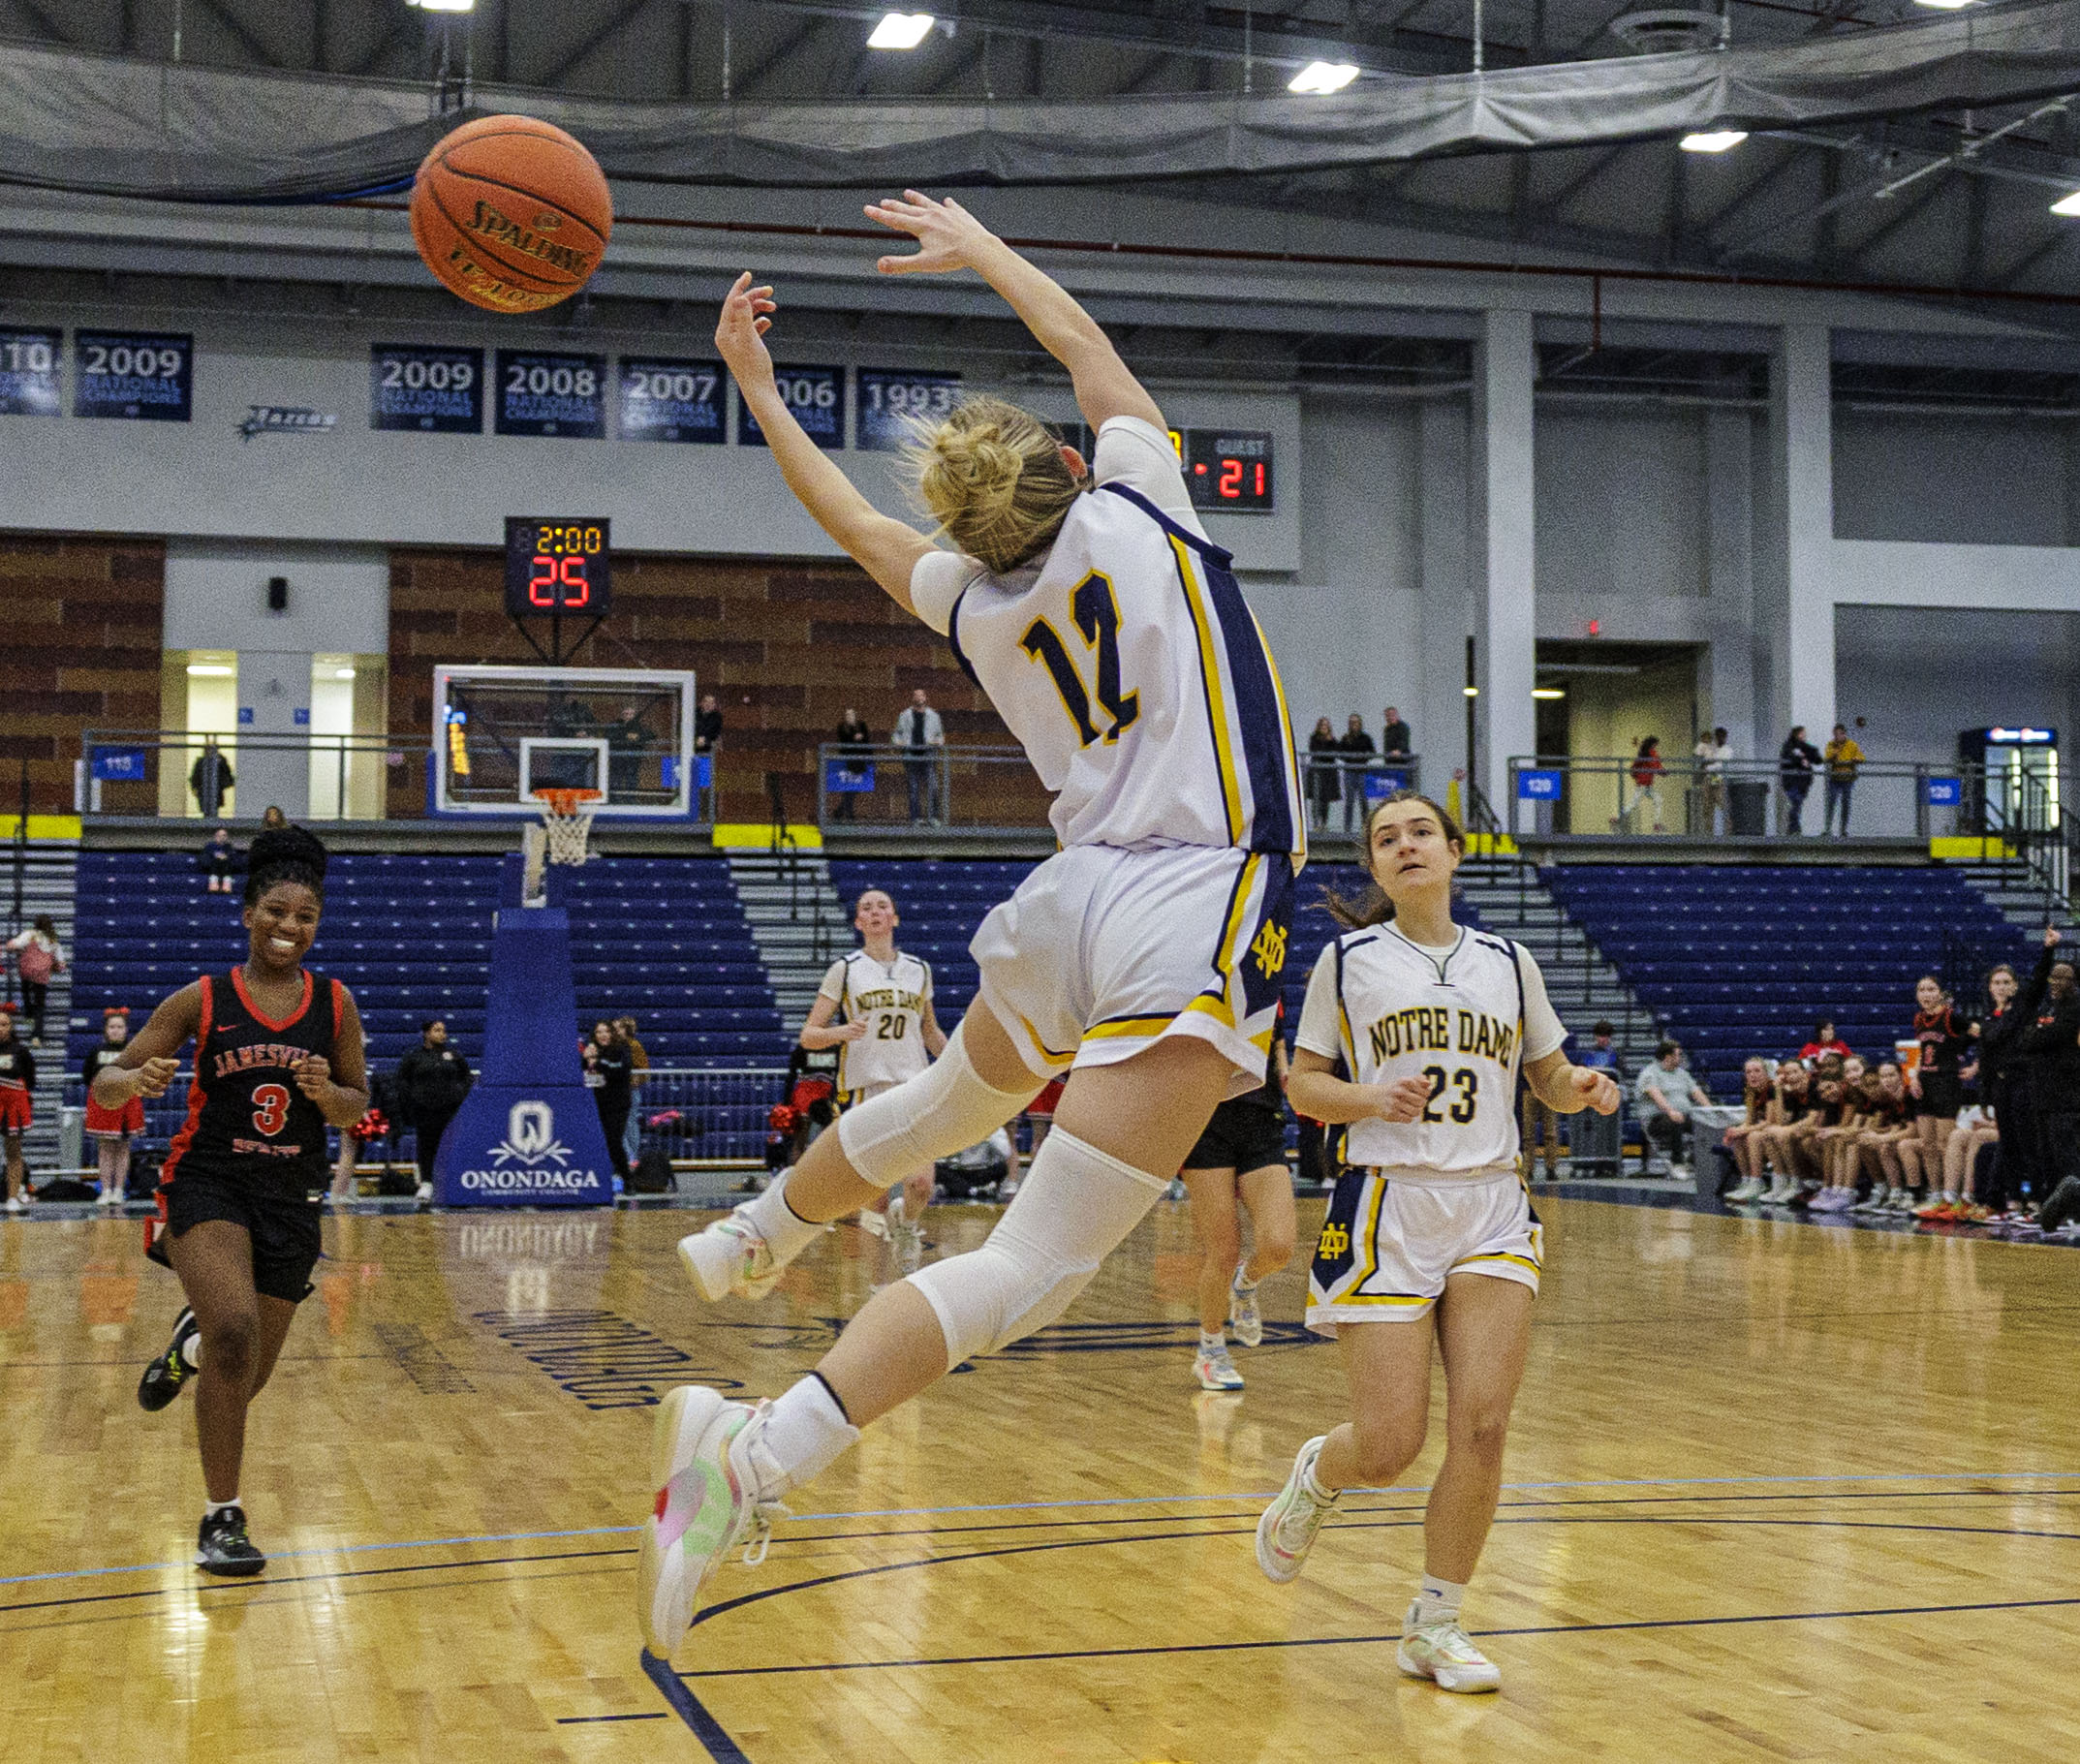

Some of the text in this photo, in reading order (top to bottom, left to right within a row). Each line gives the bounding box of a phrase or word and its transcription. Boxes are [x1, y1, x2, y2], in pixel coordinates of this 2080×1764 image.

[465, 200, 595, 279] SPALDING
[0, 342, 51, 373] 10
[85, 346, 182, 377] 2009
[382, 359, 474, 390] 2009
[506, 365, 597, 397] 2008
[628, 372, 717, 402] 2007
[775, 379, 837, 408] 006
[867, 384, 950, 413] 1993
[1220, 459, 1264, 498] 21
[537, 527, 601, 553] 2:00
[529, 556, 589, 607] 25
[1017, 568, 1141, 750] 12
[877, 1013, 907, 1040] 20
[1367, 1006, 1449, 1068] NOTRE
[251, 1083, 292, 1136] 3
[1420, 1065, 1477, 1125] 23
[460, 1169, 600, 1190] ONONDAGA
